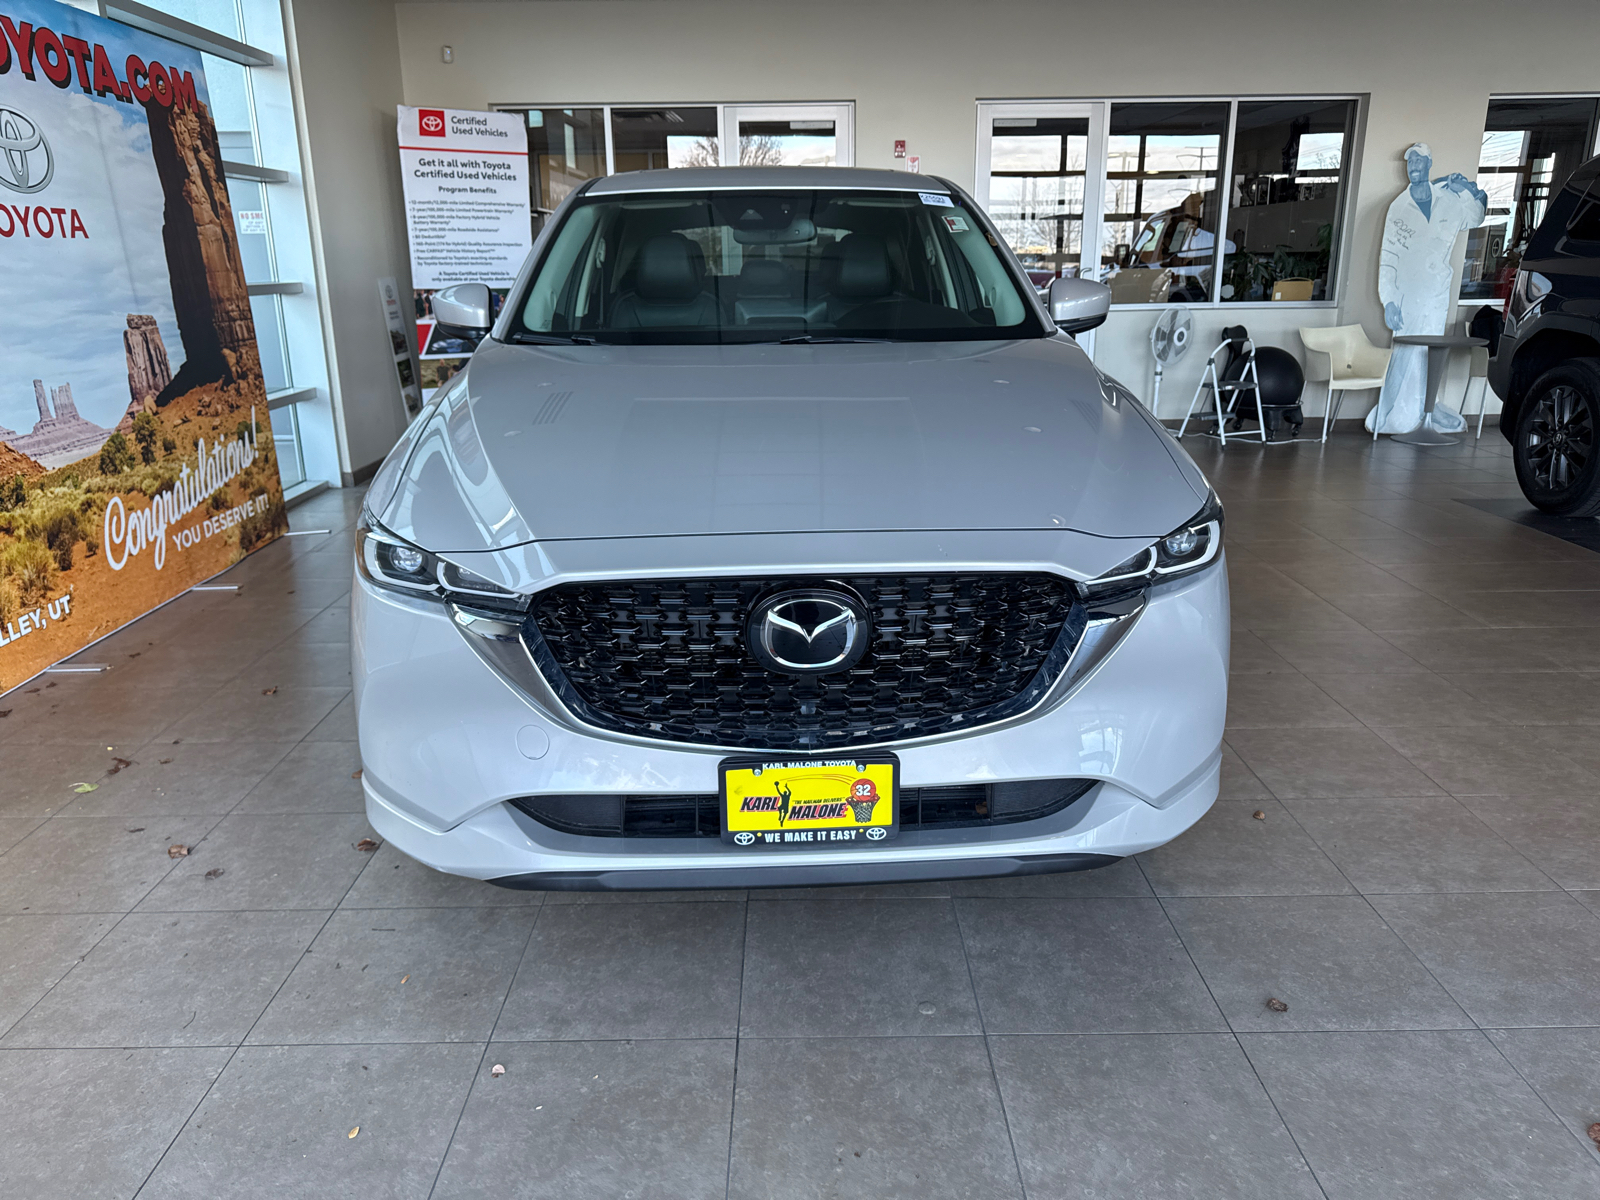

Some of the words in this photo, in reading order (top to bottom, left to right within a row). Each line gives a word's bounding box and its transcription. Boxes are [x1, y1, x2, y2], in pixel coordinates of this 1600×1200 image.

[451, 116, 487, 126] Certified
[452, 126, 473, 135] Used
[474, 128, 508, 137] Vehicles
[418, 158, 436, 166] Get
[438, 158, 445, 167] it
[446, 159, 458, 168] all
[460, 160, 480, 168] with
[482, 161, 511, 171] Toyota
[414, 170, 454, 178] Certified
[456, 171, 479, 179] Used
[481, 172, 517, 181] Vehicles
[438, 186, 468, 194] Program
[104, 405, 258, 570] Congratulations!
[172, 524, 201, 551] YOU
[202, 500, 255, 538] DESERVE
[255, 493, 269, 513] IT!
[47, 594, 70, 620] UT
[856, 784, 871, 796] 32
[740, 796, 780, 812] KARL
[787, 802, 848, 821] MALONE
[764, 833, 780, 843] WE
[785, 832, 814, 842] MAKE
[817, 831, 827, 841] IT
[830, 830, 856, 840] EASY
